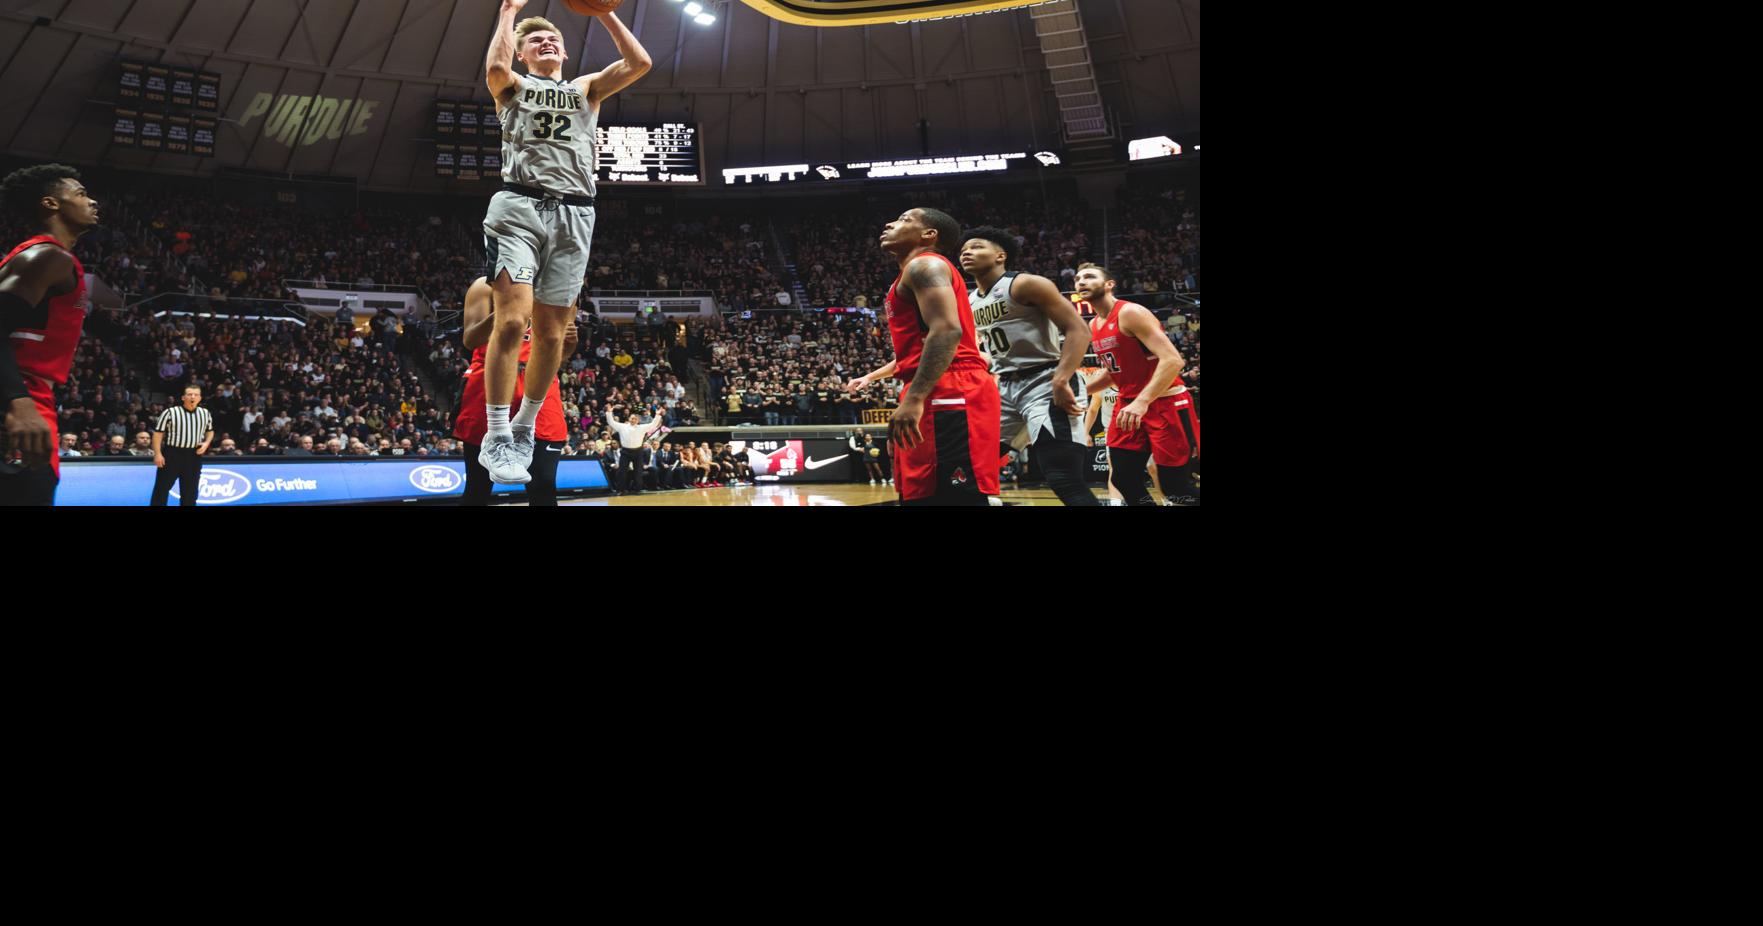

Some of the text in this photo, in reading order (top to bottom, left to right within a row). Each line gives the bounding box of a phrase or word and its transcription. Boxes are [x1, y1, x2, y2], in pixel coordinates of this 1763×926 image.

[524, 88, 581, 109] PURDUE
[237, 92, 381, 147] PURDUE
[533, 112, 571, 141] 32
[973, 301, 1009, 325] URDUE
[256, 479, 275, 491] Go
[275, 478, 317, 491] Further
[421, 469, 452, 488] Ford
